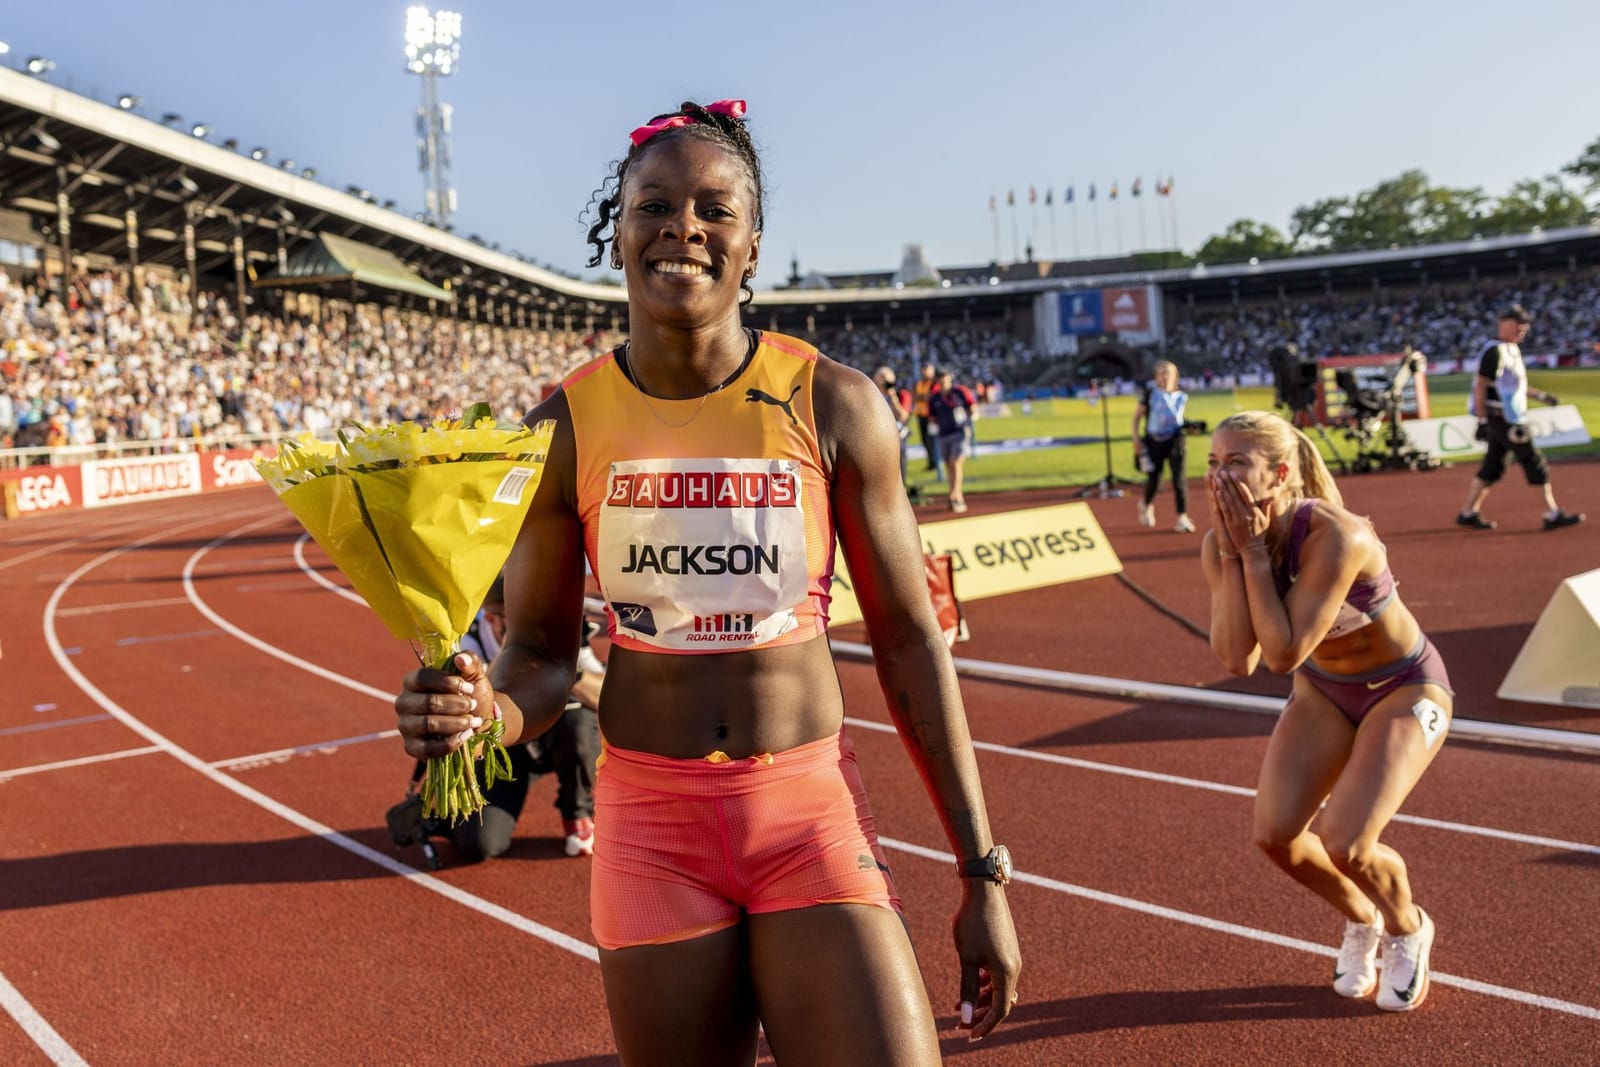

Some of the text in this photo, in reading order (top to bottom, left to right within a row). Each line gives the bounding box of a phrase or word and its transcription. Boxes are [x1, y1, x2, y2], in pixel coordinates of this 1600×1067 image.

[95, 461, 192, 499] BAUHAUS
[609, 475, 794, 505] BAUHAUS
[621, 544, 779, 575] JACKSON
[974, 526, 1096, 573] express
[686, 631, 760, 642] ROAD RENTAL
[1428, 709, 1439, 732] 2
